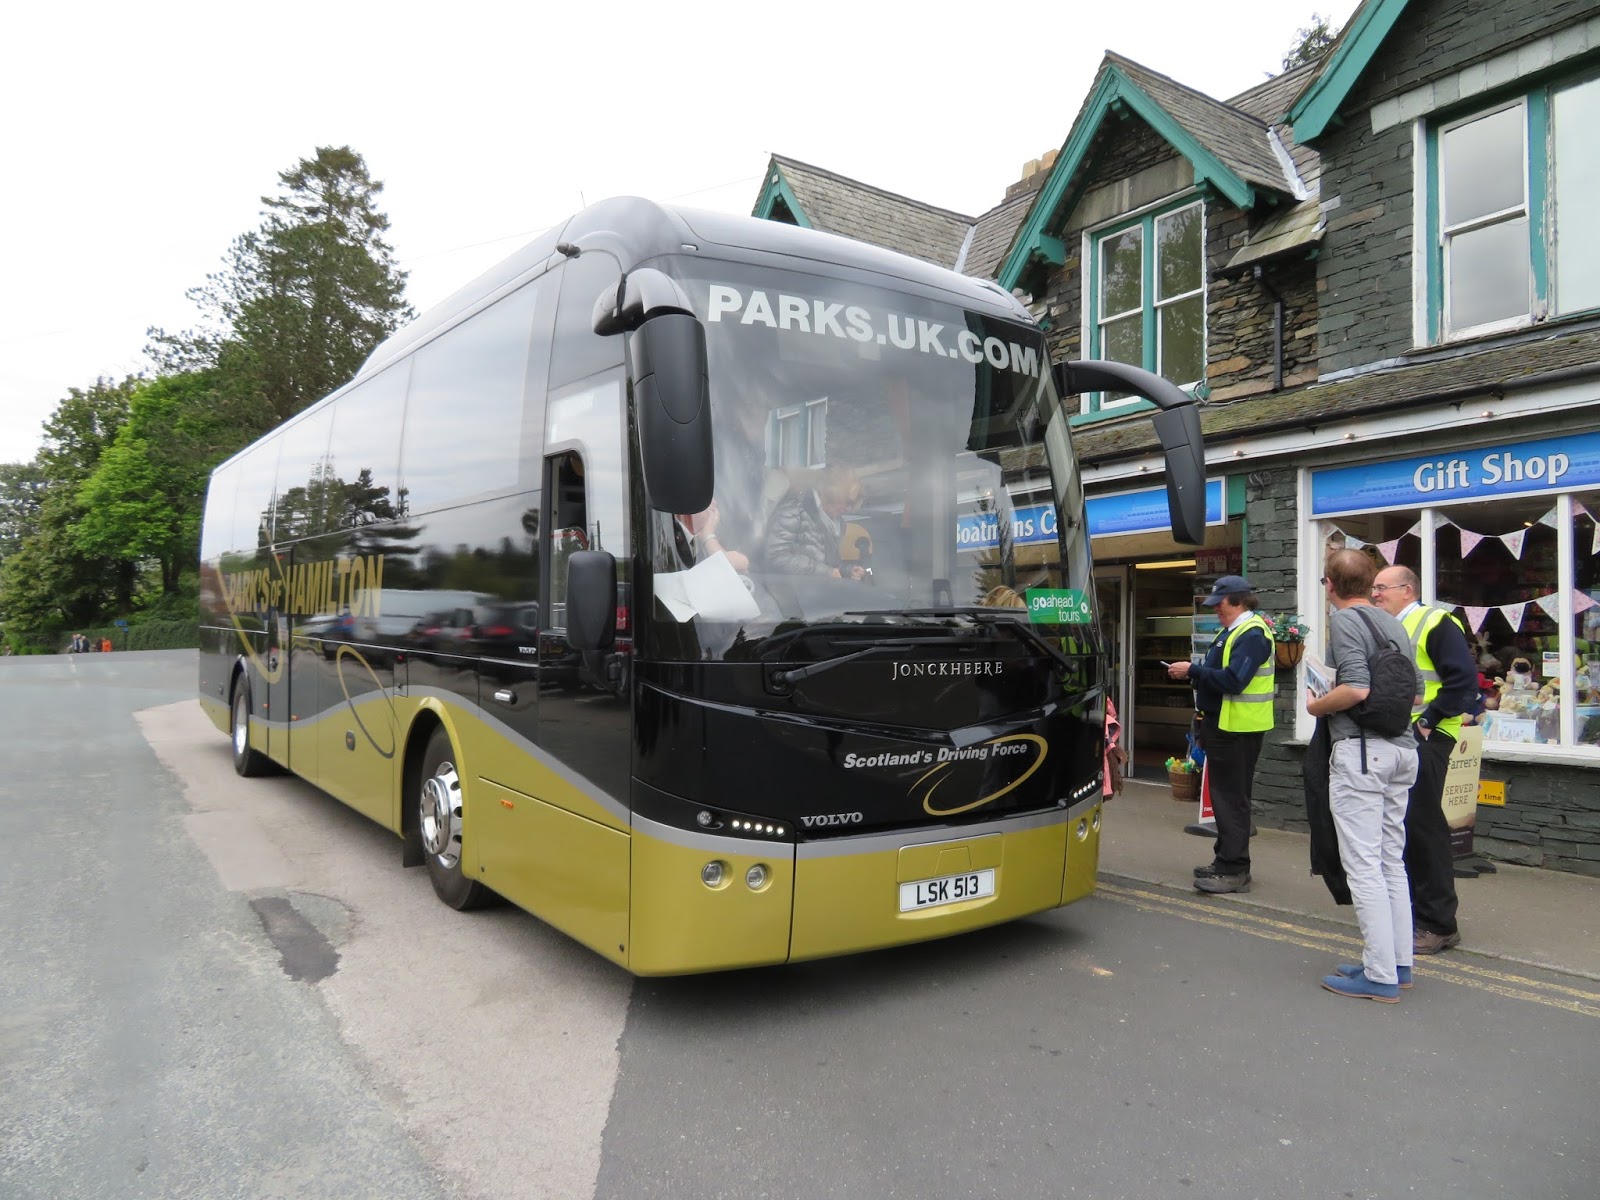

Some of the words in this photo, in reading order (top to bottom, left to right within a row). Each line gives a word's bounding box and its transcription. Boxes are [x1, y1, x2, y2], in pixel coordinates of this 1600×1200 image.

[708, 285, 1039, 378] PARKS.UK.COM
[1413, 459, 1470, 492] Gift
[1481, 452, 1569, 485] Shop
[957, 519, 1034, 543] oatmns
[229, 568, 271, 613] PARK'S
[270, 579, 282, 607] OF
[284, 554, 384, 618] HAMILTON
[1058, 610, 1080, 622] tours
[892, 662, 1003, 680] JONCKHEERE
[843, 750, 933, 769] Scotland's
[937, 747, 989, 762] Driving
[992, 742, 1028, 757] Force
[1445, 783, 1474, 796] SERVED
[1448, 794, 1469, 806] HERE
[1484, 793, 1502, 802] time
[800, 811, 864, 828] VOLVO
[916, 879, 949, 906] LSK
[954, 874, 979, 898] 513
